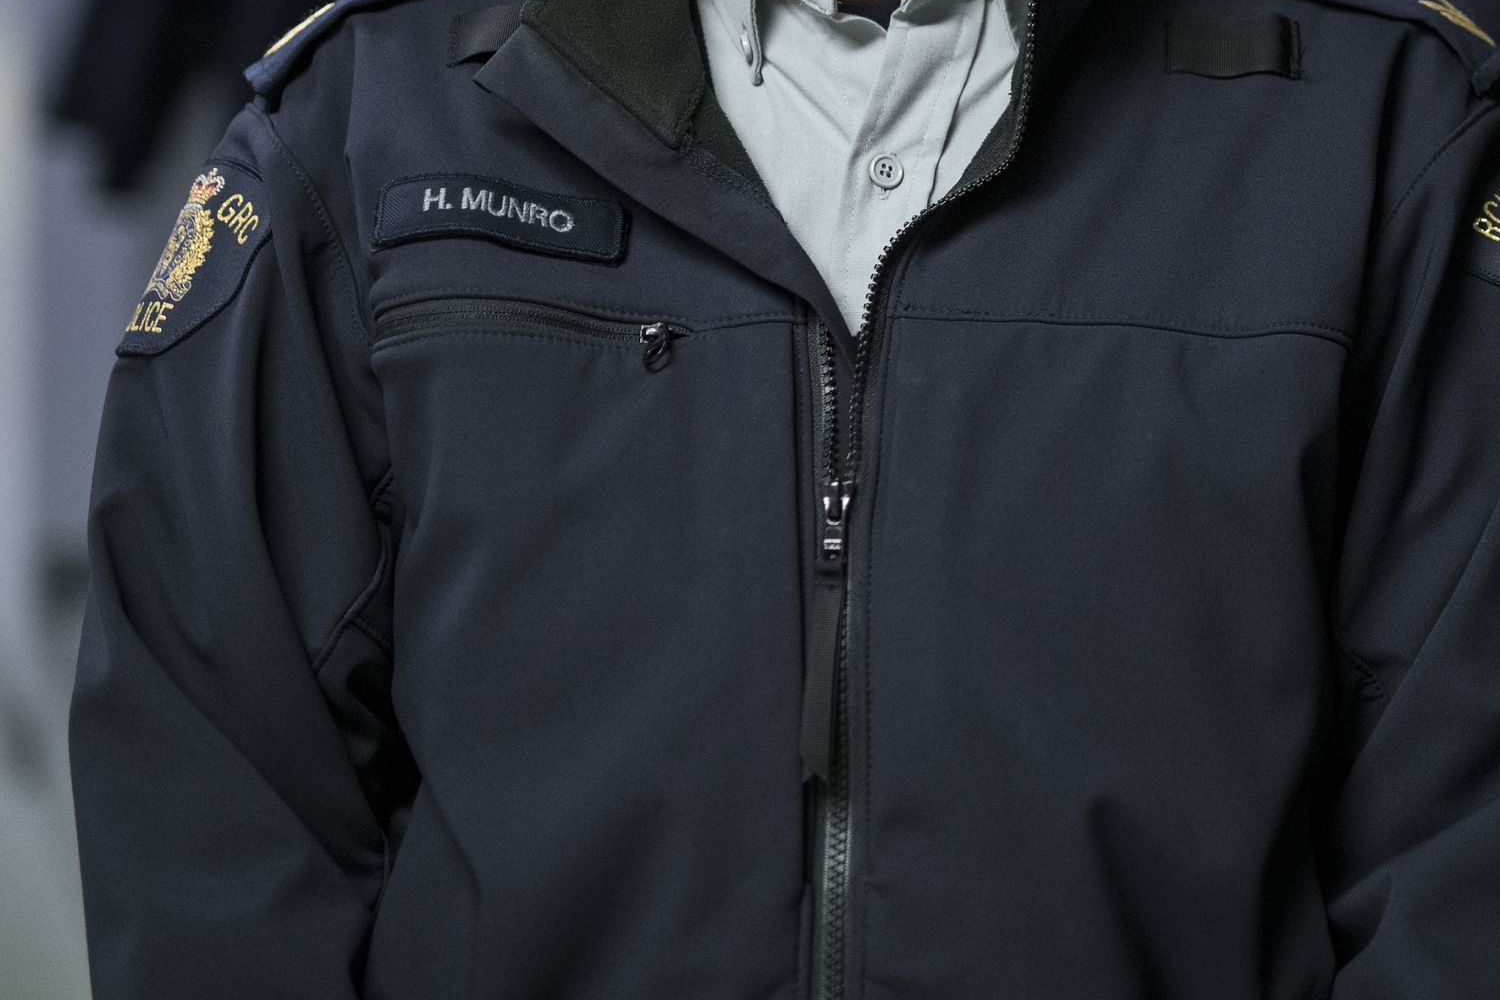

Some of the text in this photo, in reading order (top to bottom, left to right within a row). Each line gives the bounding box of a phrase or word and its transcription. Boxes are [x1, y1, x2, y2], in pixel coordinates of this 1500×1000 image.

[216, 192, 259, 245] GRC
[422, 186, 575, 233] H. MUNRO
[126, 301, 174, 333] LICE
